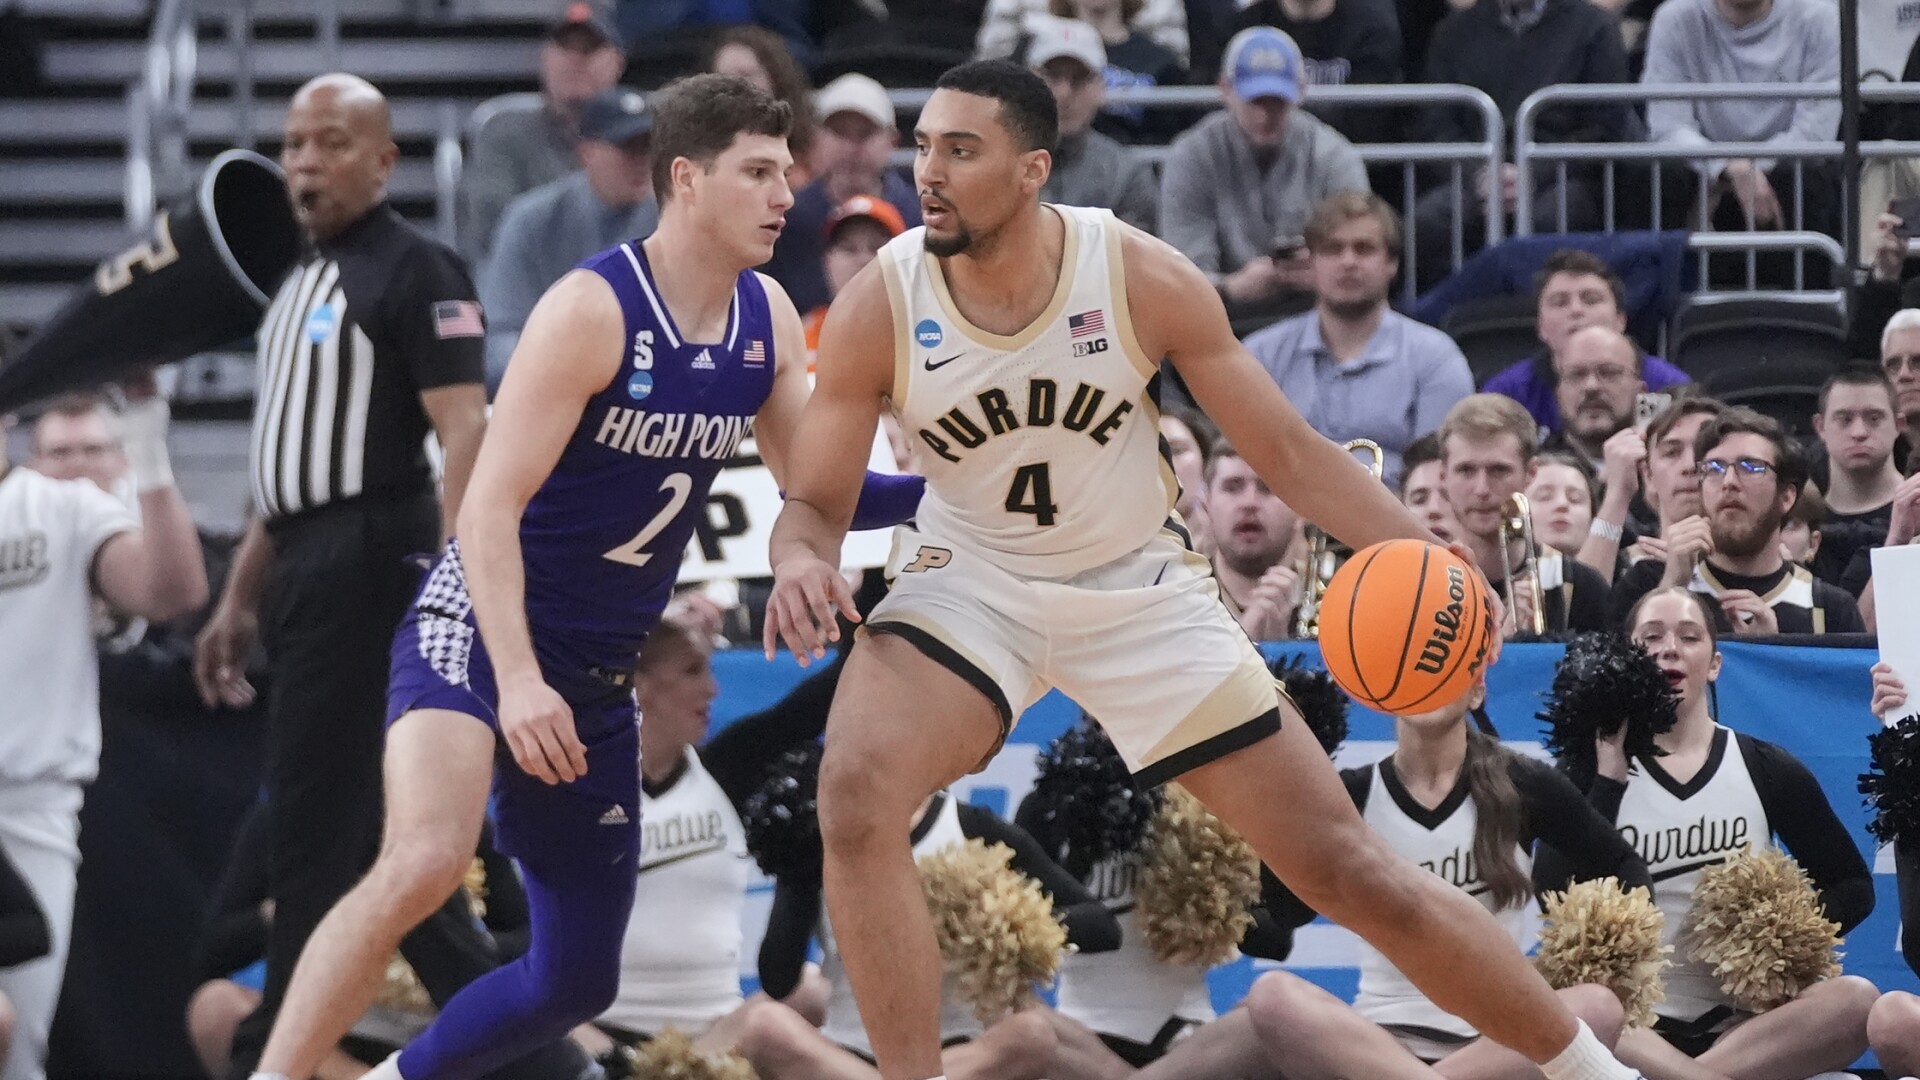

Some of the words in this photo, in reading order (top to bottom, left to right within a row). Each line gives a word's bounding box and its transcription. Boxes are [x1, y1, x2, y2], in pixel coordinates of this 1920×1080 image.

[594, 405, 687, 459] HIGH
[918, 378, 1135, 464] PURDUE
[601, 471, 693, 568] 2
[1004, 461, 1059, 527] 4
[902, 544, 953, 573] P
[1413, 565, 1465, 675] Wilson
